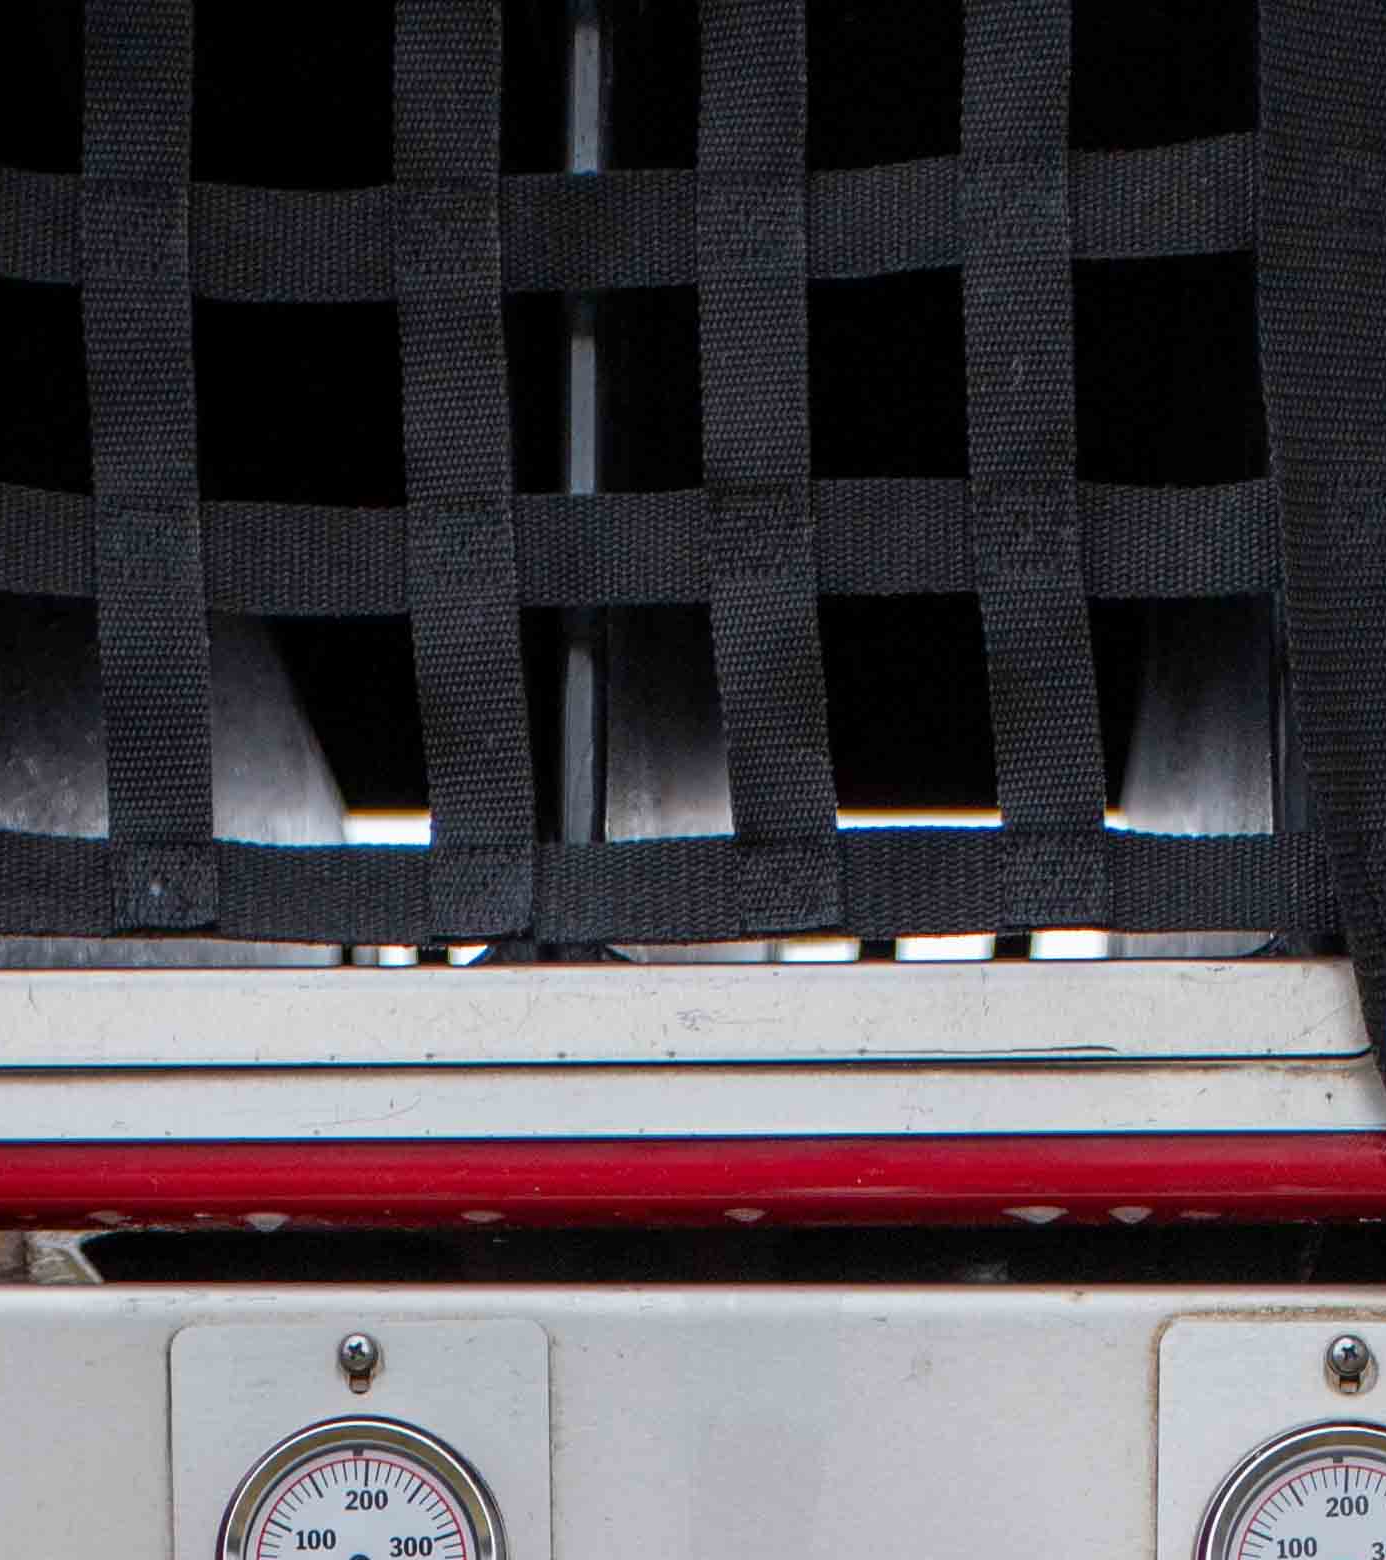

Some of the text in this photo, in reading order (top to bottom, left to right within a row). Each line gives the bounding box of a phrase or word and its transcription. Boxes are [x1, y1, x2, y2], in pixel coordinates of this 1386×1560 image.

[344, 1490, 389, 1511] 200
[1325, 1496, 1369, 1518] 200
[296, 1529, 336, 1550] 100
[389, 1537, 433, 1558] 300
[1276, 1537, 1317, 1560] 100
